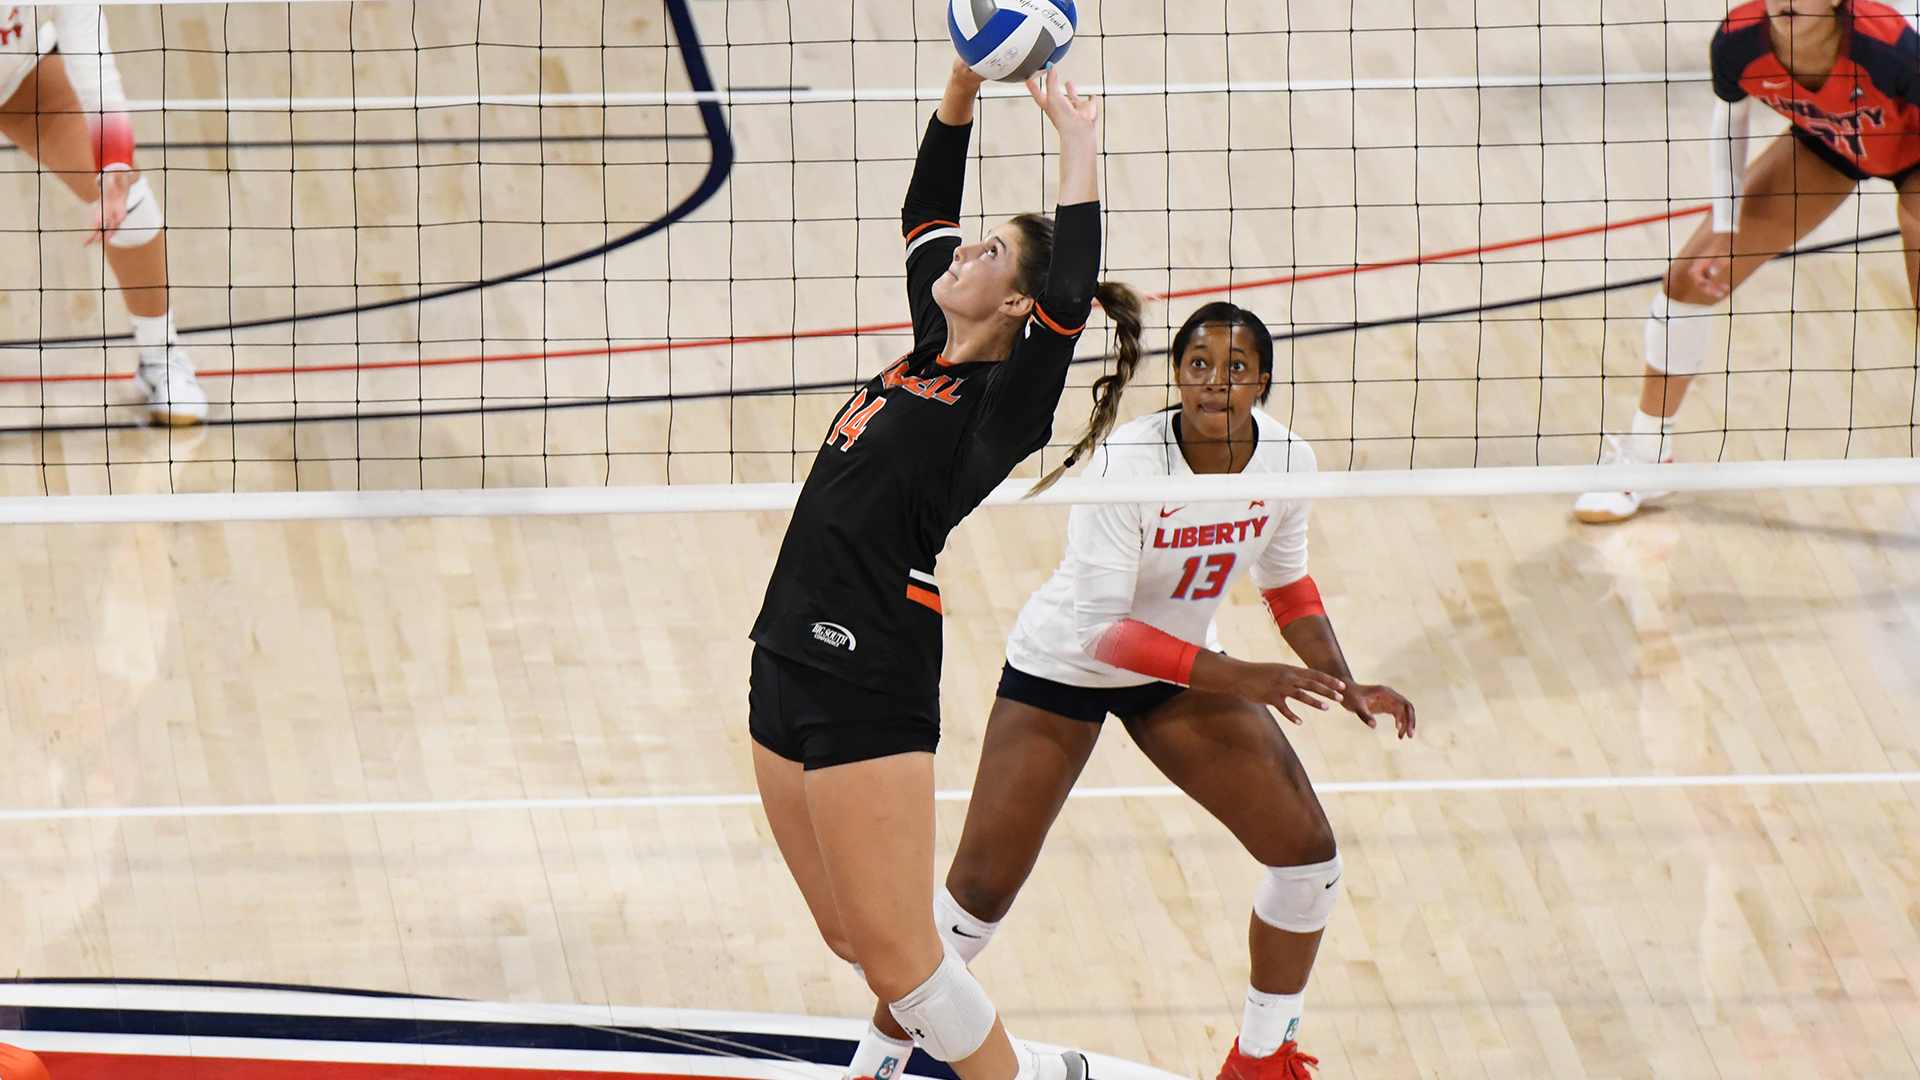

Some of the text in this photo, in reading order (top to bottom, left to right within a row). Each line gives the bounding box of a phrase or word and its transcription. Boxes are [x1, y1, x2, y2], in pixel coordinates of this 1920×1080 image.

[1041, 9, 1067, 31] Touch
[826, 387, 887, 452] 14
[1153, 515, 1269, 549] LIBERTY
[1170, 552, 1237, 601] 13
[811, 623, 849, 646] BIG SOUTH
